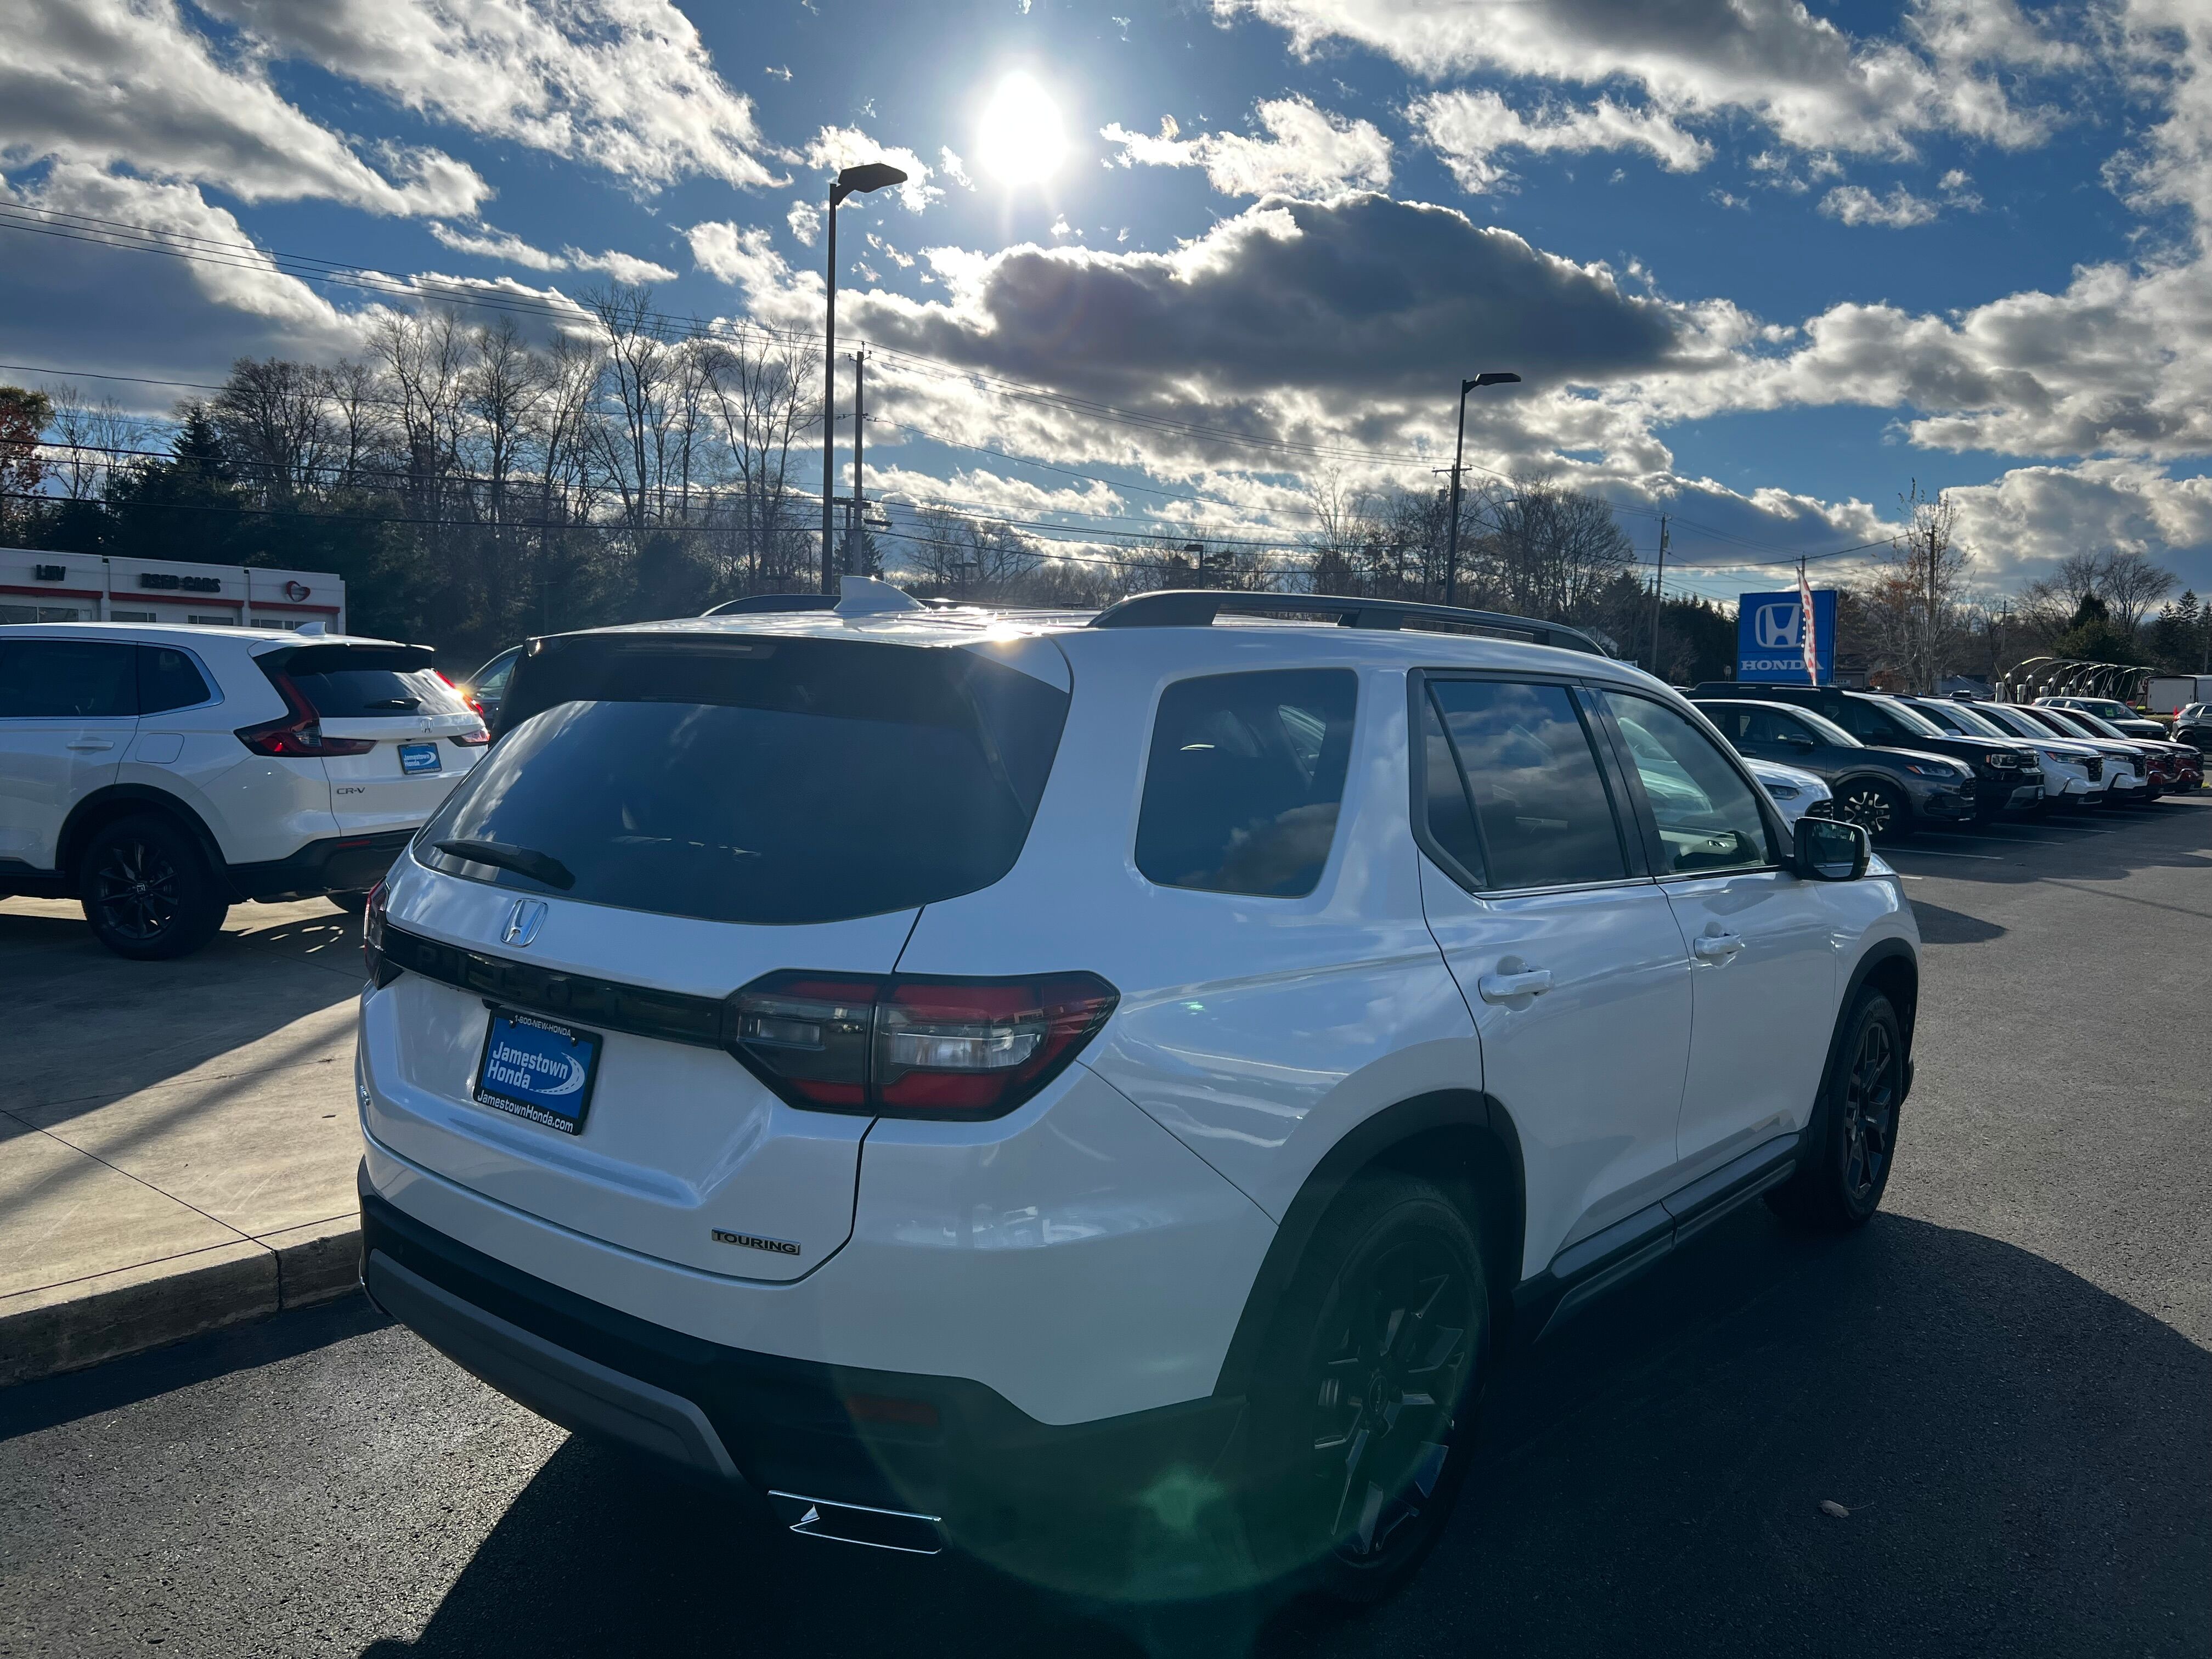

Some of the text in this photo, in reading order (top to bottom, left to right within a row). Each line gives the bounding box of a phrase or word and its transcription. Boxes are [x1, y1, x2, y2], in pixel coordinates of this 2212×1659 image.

[184, 576, 221, 592] CARS
[515, 1014, 572, 1037] 1-800-NEW-HONDA
[492, 1041, 569, 1080] Jamestown
[487, 1059, 532, 1090] Honda
[477, 1090, 574, 1133] JamestownHonda.com
[714, 1231, 796, 1253] TOURING
